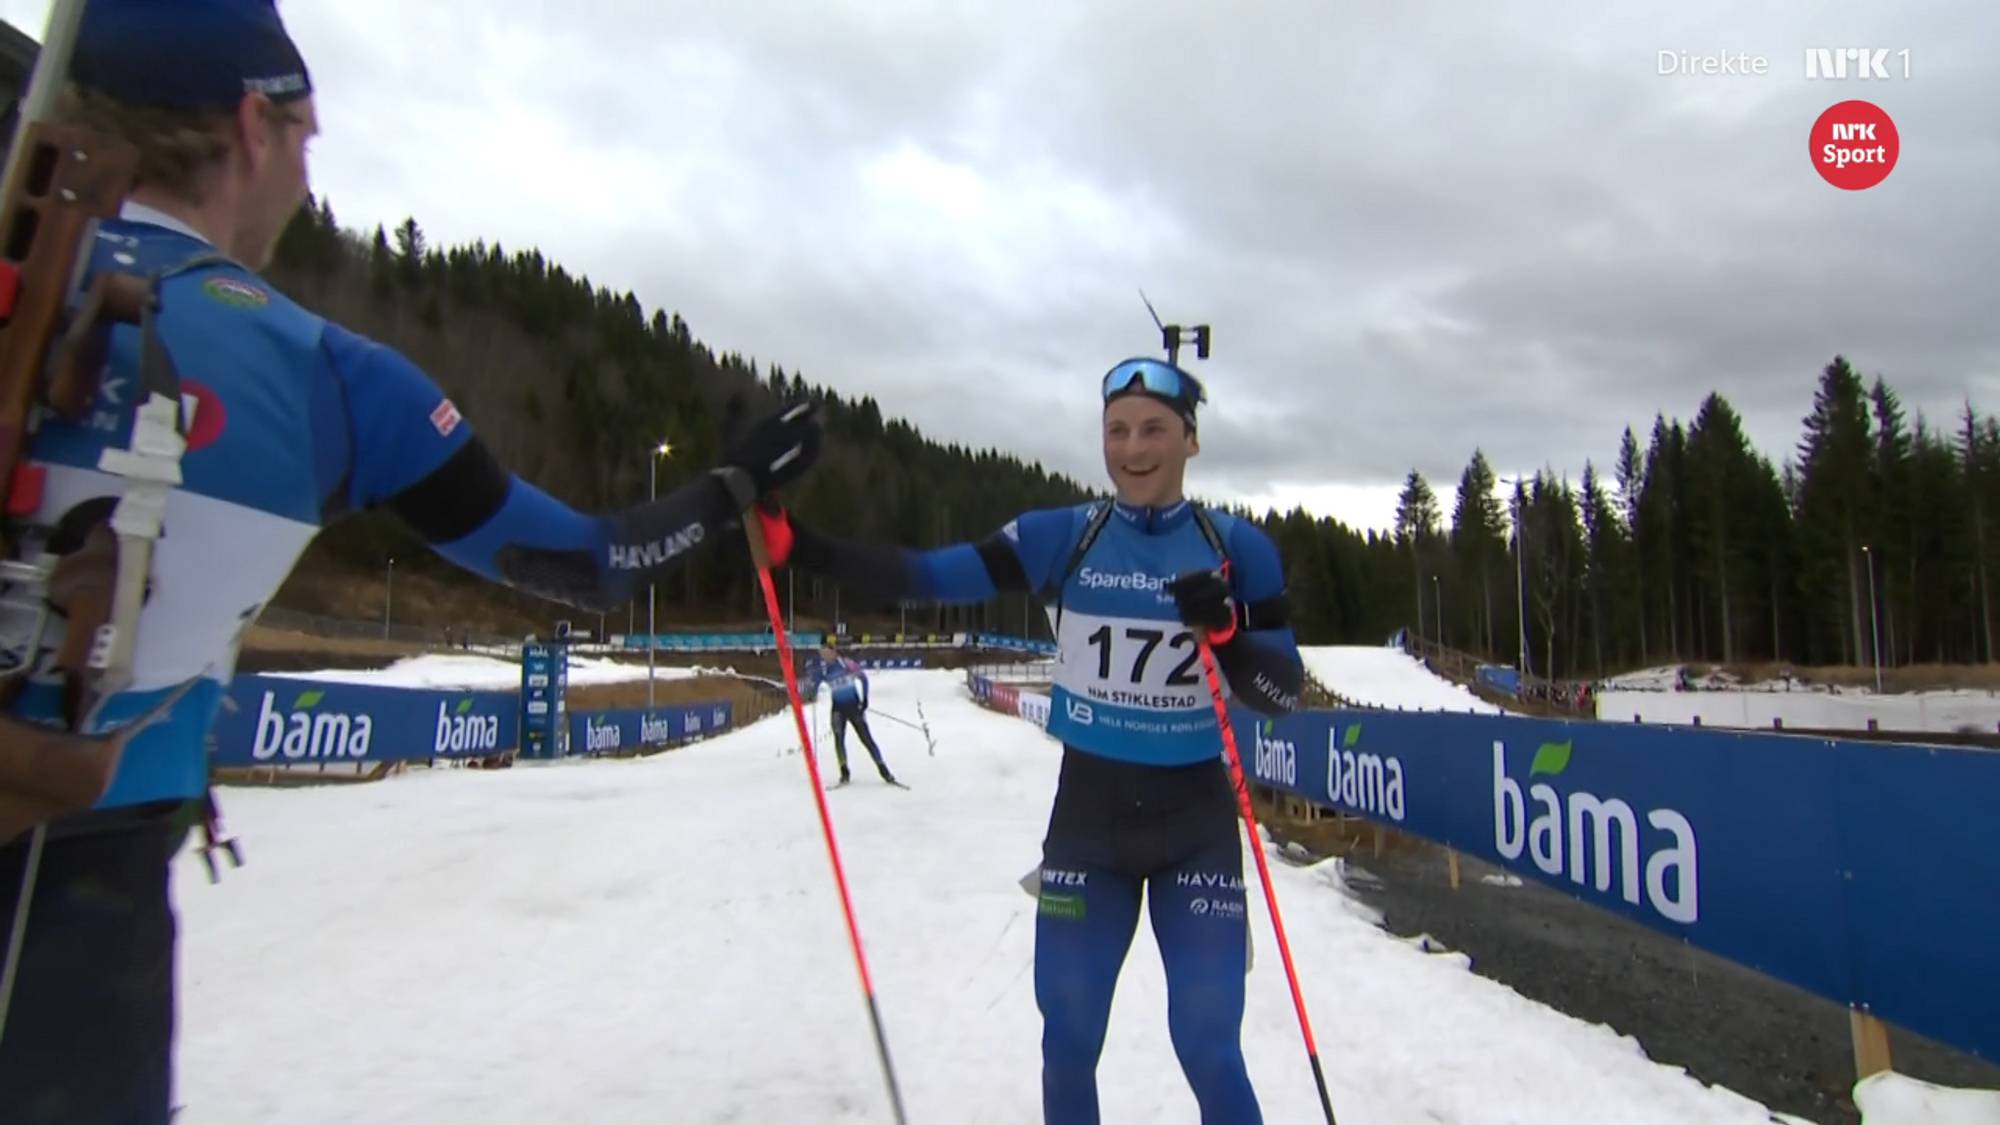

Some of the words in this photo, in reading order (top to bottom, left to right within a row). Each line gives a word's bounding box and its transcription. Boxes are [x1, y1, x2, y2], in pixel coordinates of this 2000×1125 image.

[608, 522, 705, 569] HAVLAND
[1088, 624, 1200, 687] 172
[252, 690, 372, 760] bama
[434, 699, 498, 752] bama
[1112, 690, 1197, 708] STIKLESTAD
[586, 716, 621, 751] bama
[1255, 720, 1297, 788] bama
[1327, 727, 1406, 821] bama
[1493, 740, 1699, 924] bama
